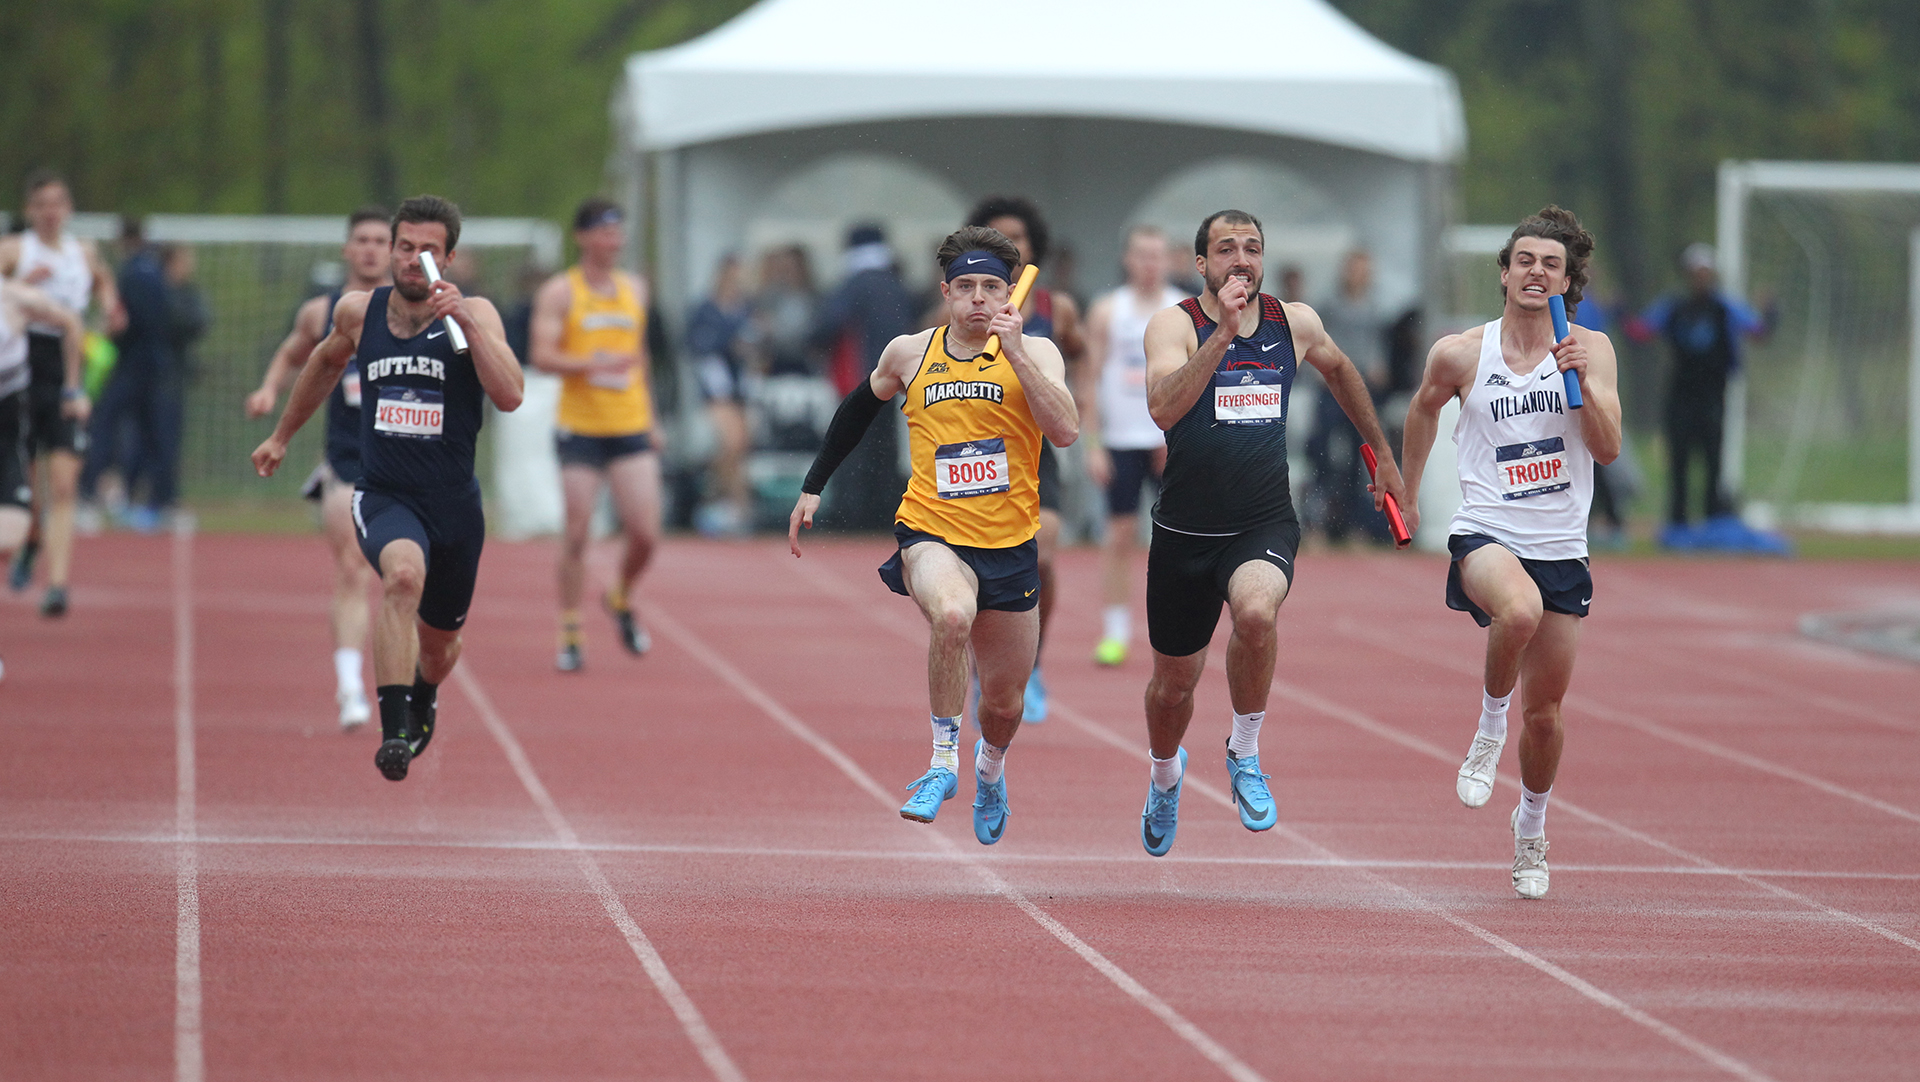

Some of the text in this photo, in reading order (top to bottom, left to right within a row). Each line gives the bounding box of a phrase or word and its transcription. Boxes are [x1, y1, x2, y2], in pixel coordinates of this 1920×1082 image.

[367, 356, 445, 381] BUTLER
[924, 381, 1003, 408] MARQUETTE
[1218, 393, 1280, 407] FEYERSINGER
[1490, 390, 1564, 423] VILLANOVA
[380, 406, 440, 427] VESTUTO
[949, 460, 997, 484] BOOS
[1505, 458, 1562, 485] TROUP
